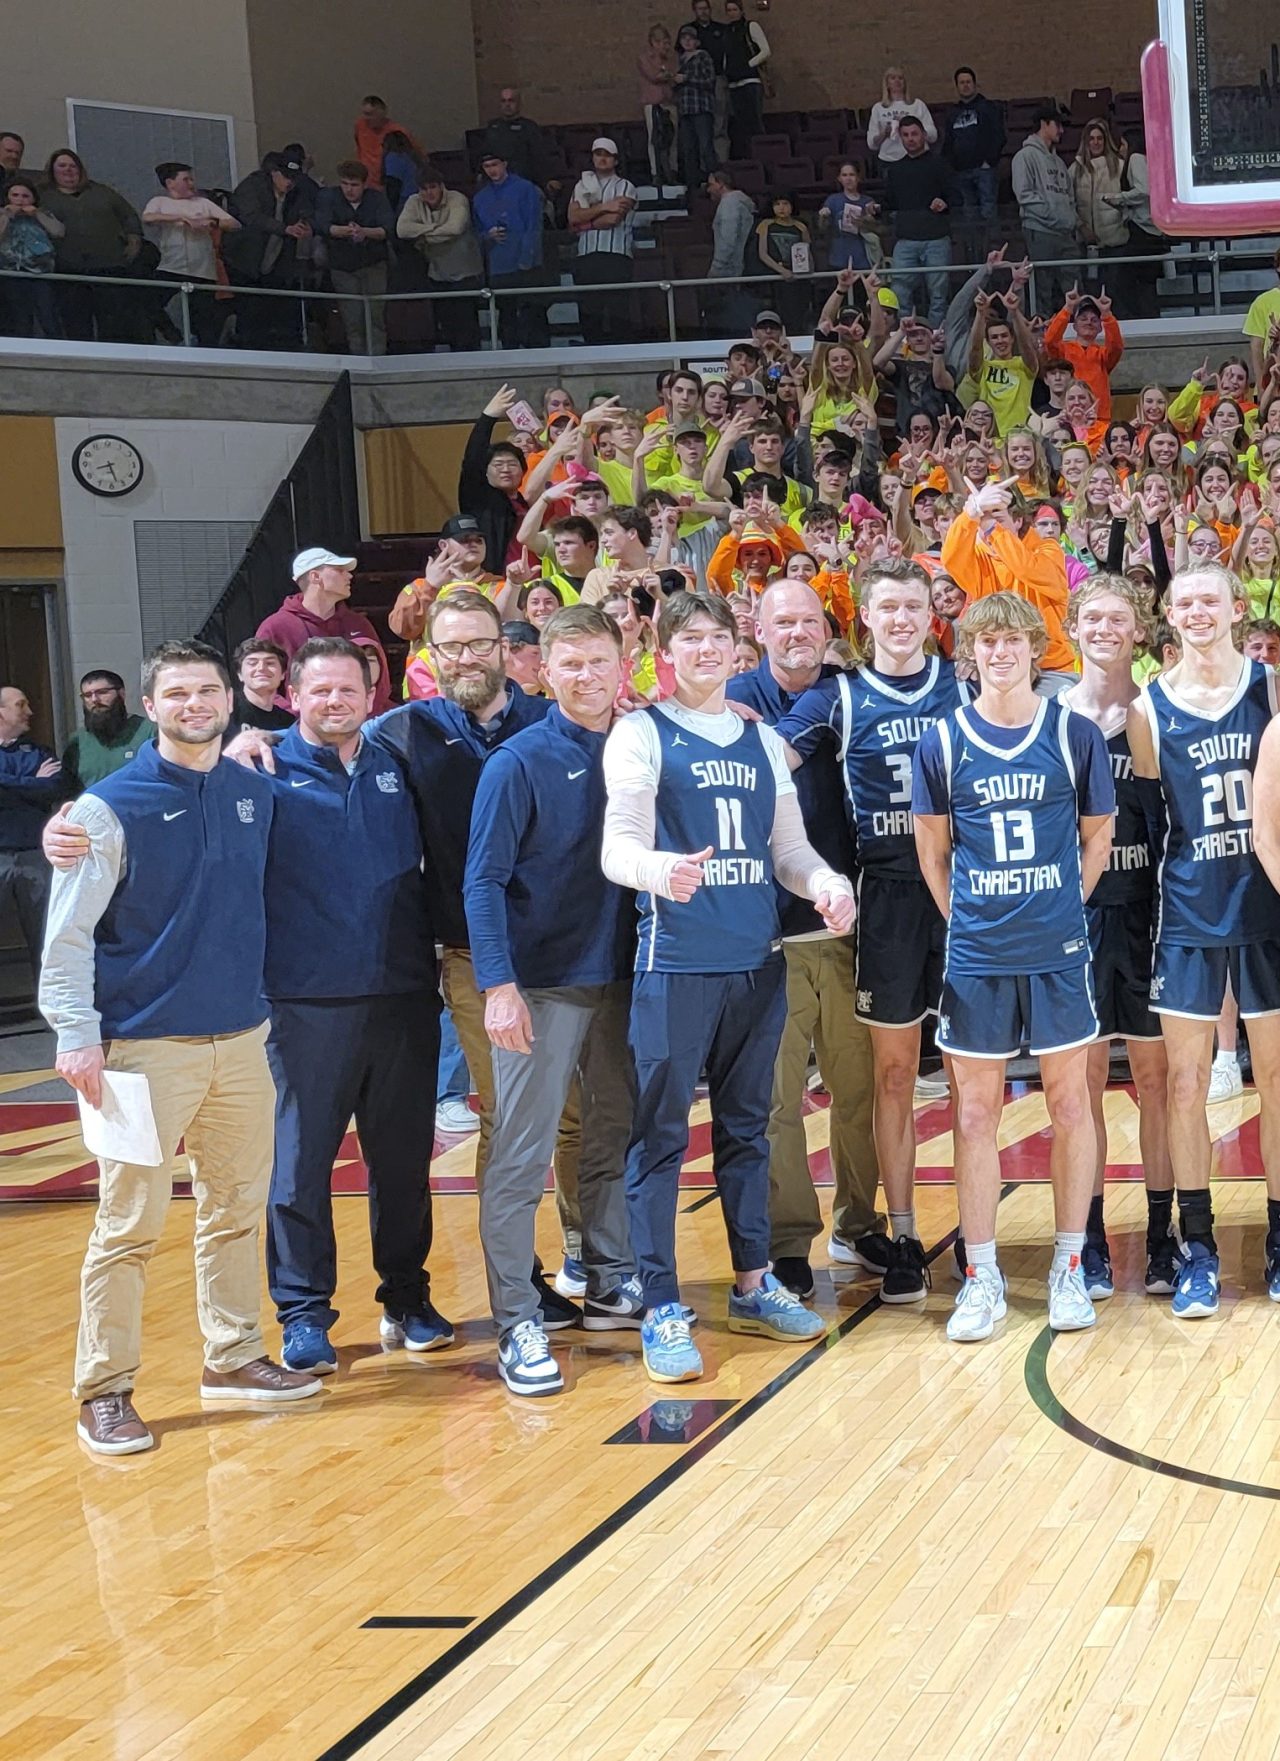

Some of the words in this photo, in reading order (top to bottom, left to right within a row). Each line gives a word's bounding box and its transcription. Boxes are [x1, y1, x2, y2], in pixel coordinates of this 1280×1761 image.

[1187, 733, 1251, 771] SOUTH
[690, 760, 757, 792] SOUTH
[973, 773, 1046, 806] SOUTH
[1201, 769, 1253, 827] 20
[715, 797, 747, 850] 11
[990, 810, 1036, 863] 13
[968, 863, 1062, 896] CHRISTIAN
